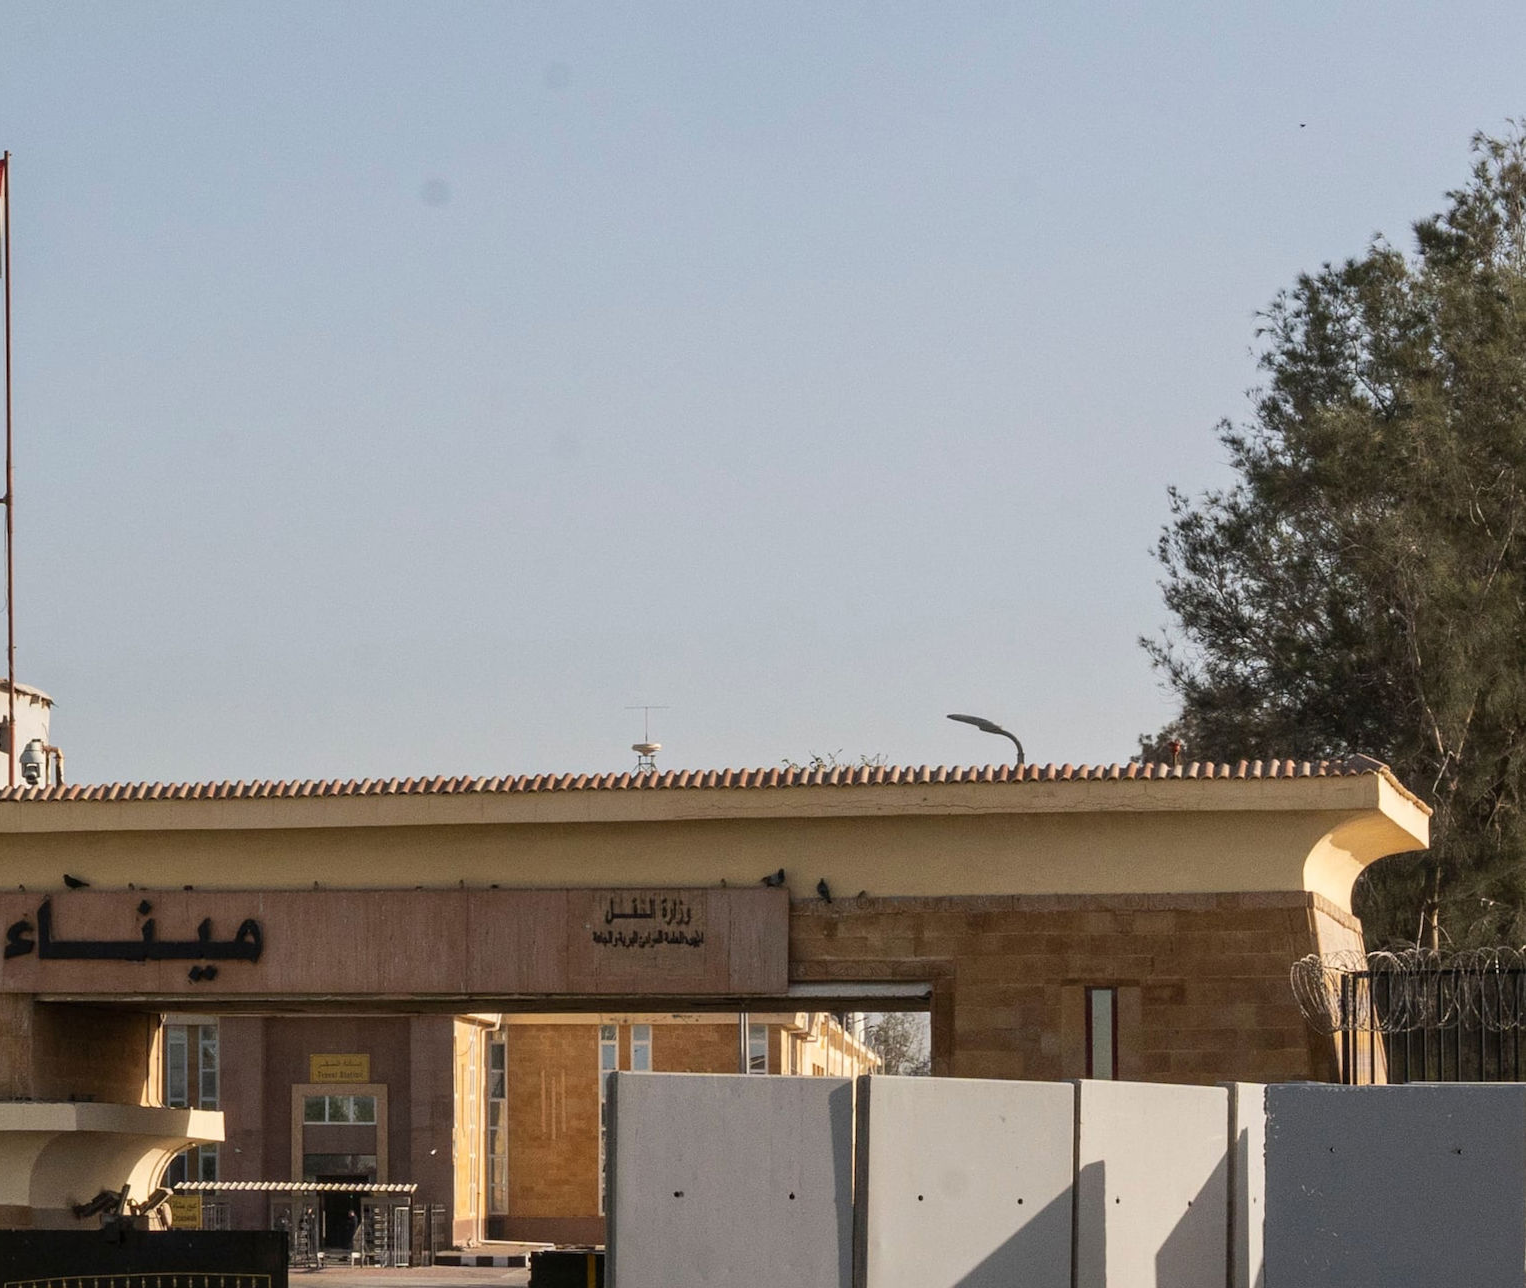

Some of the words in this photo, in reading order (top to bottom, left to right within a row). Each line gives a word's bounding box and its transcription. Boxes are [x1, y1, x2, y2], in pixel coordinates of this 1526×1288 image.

[605, 898, 656, 924] النقل
[662, 898, 691, 925] وزارة
[3, 896, 263, 981] ميناء
